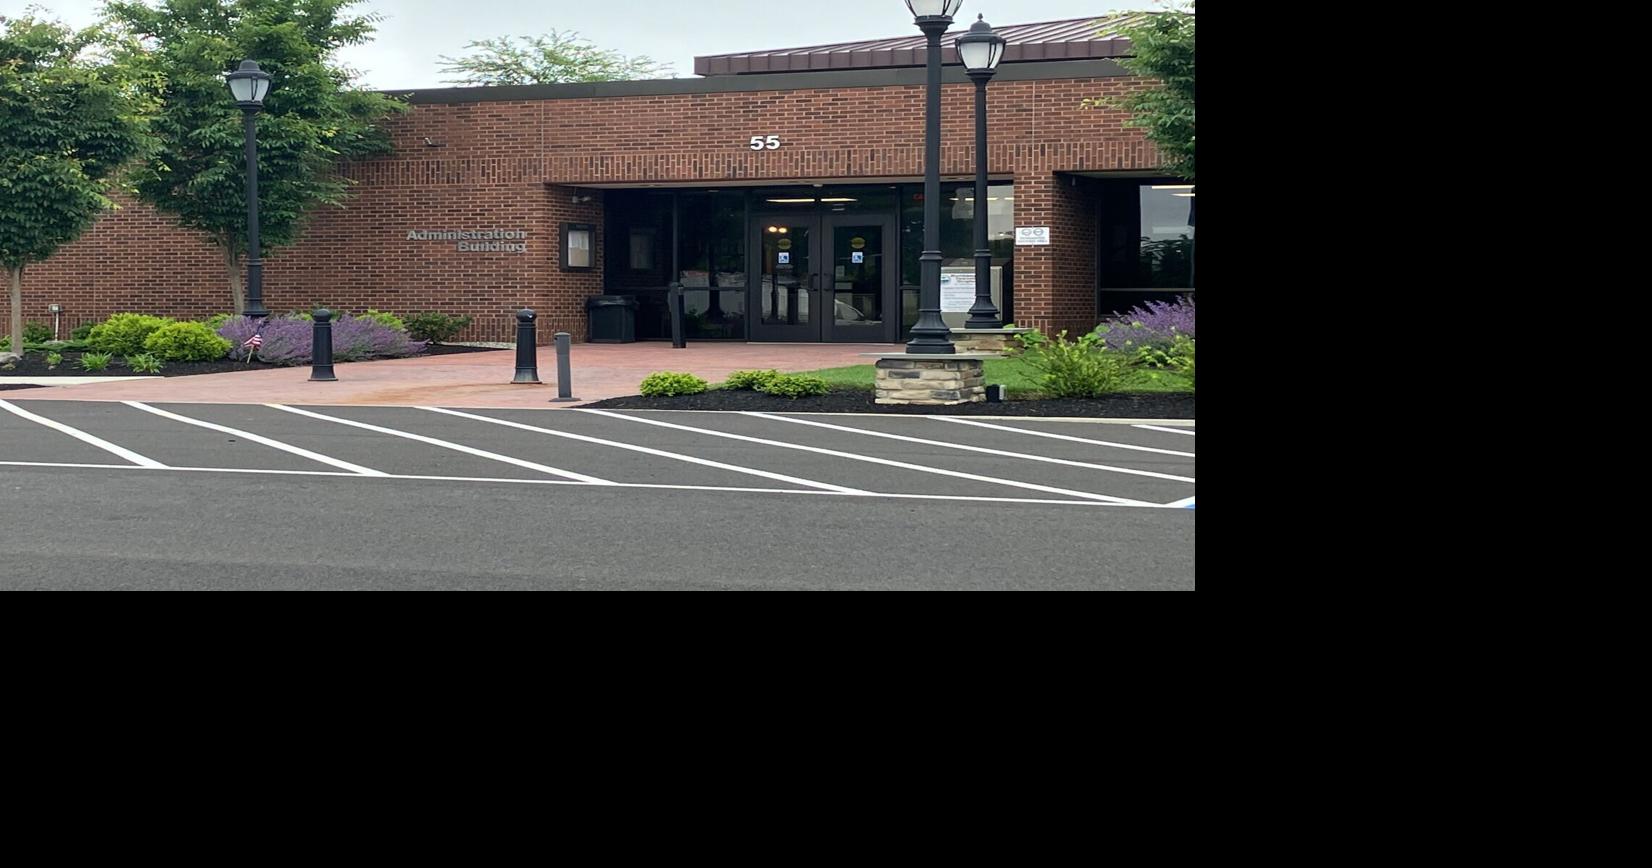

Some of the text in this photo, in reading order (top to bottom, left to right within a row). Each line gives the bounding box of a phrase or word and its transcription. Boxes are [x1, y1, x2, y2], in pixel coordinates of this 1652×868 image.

[750, 135, 780, 150] 55
[406, 228, 527, 240] Administration
[457, 240, 527, 253] Building
